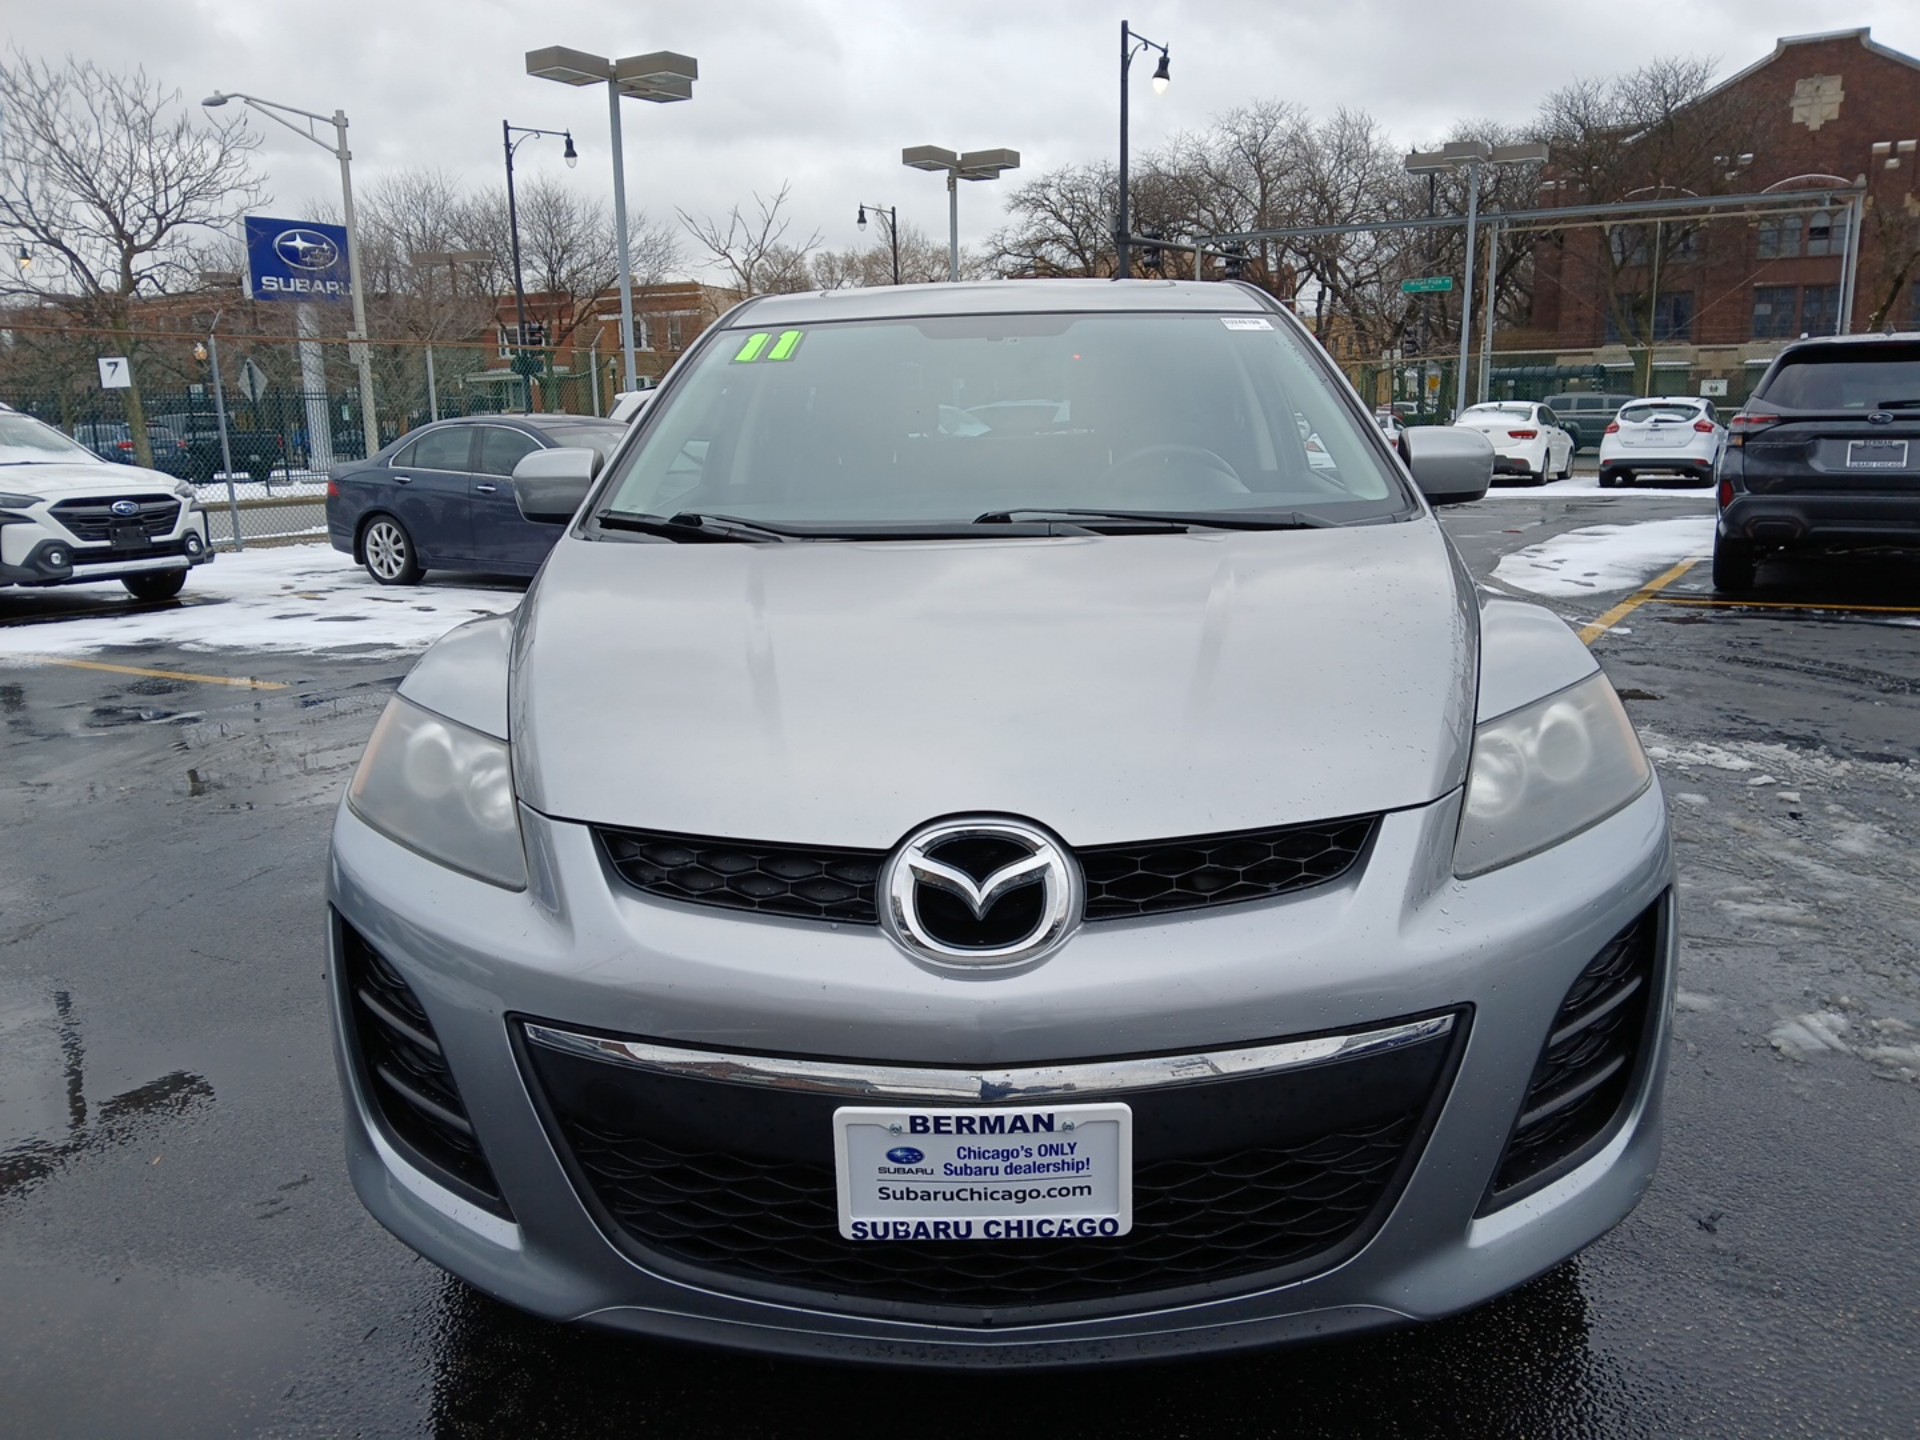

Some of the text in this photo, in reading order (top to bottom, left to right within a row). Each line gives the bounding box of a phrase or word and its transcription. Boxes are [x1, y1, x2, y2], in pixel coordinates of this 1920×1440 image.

[261, 276, 353, 296] SUBAR
[735, 330, 804, 361] 11
[106, 361, 119, 380] 7
[909, 1113, 1055, 1134] BERMAN
[956, 1142, 1077, 1162] Chicago's ONLY
[877, 1166, 934, 1175] SUBARU
[943, 1157, 1091, 1176] Subaru dealership!
[878, 1185, 1092, 1204] SubaruChicago.com
[851, 1217, 1119, 1240] SUBARU CHICAGO
